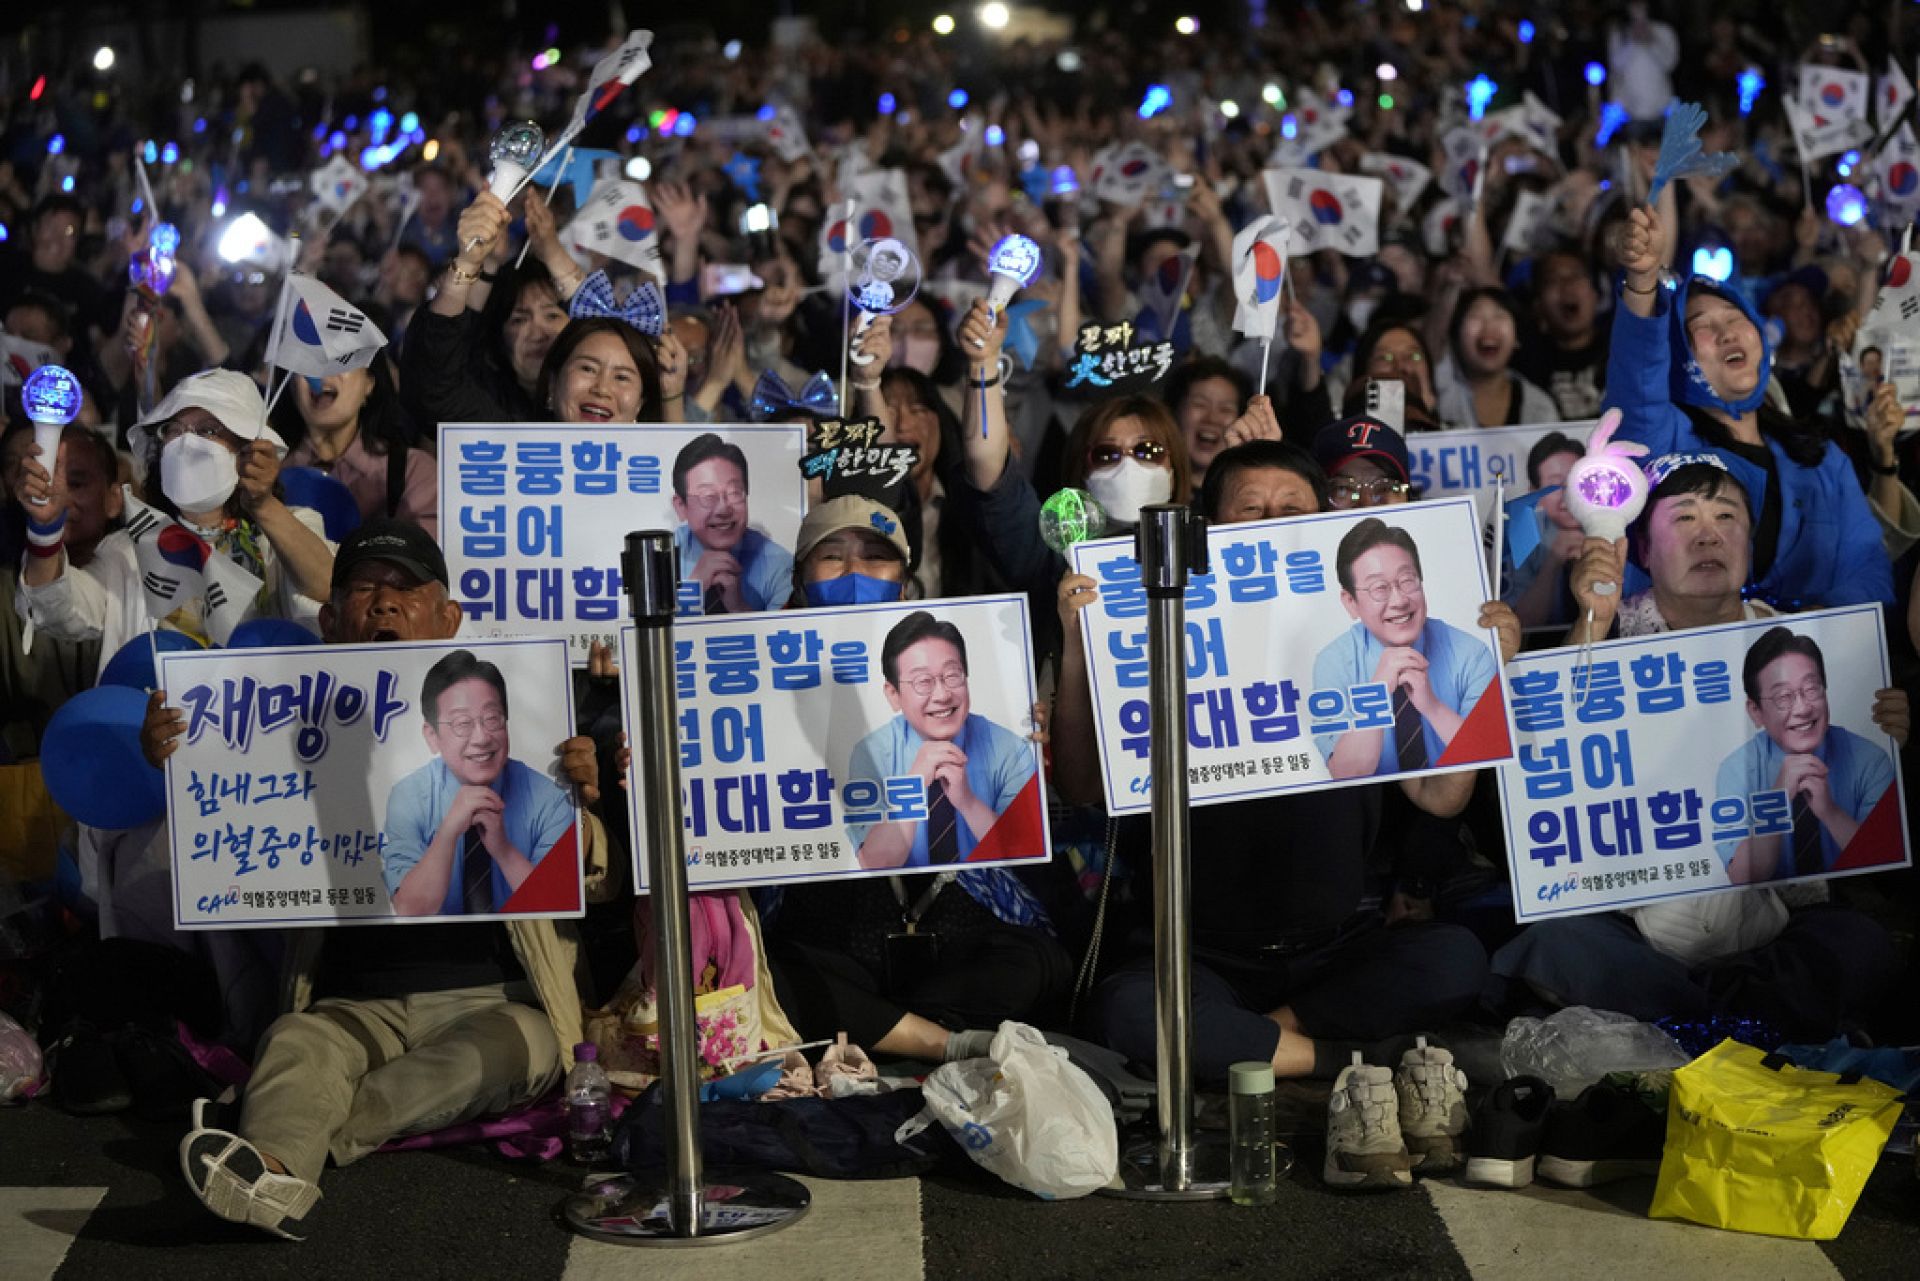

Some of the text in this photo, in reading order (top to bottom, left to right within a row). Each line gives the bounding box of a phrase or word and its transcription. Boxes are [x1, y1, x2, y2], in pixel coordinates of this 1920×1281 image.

[1347, 422, 1381, 448] T
[459, 440, 661, 495] 훌륭함을
[459, 504, 563, 558] 넘어
[459, 566, 703, 621] 위대함로
[1108, 617, 1229, 688] 넘어
[181, 668, 409, 762] 재멩아
[1509, 651, 1731, 732] 훌륭함을
[1188, 760, 1257, 784] 혈중앙대학교
[1261, 756, 1283, 775] 동문
[1288, 752, 1311, 771] 일동
[1518, 728, 1635, 799] 넘어
[704, 845, 786, 867] 의혈중앙대학교
[791, 843, 814, 862] 동문
[817, 842, 840, 859] 일동
[1527, 788, 1793, 867] 위대함으로
[242, 888, 322, 908] 의혈중앙대학교
[327, 888, 350, 906] 동문
[353, 886, 376, 904] 일동
[1582, 866, 1659, 891] 의혈중앙대학교
[1663, 862, 1685, 880] 동문
[1689, 859, 1711, 877] 일동
